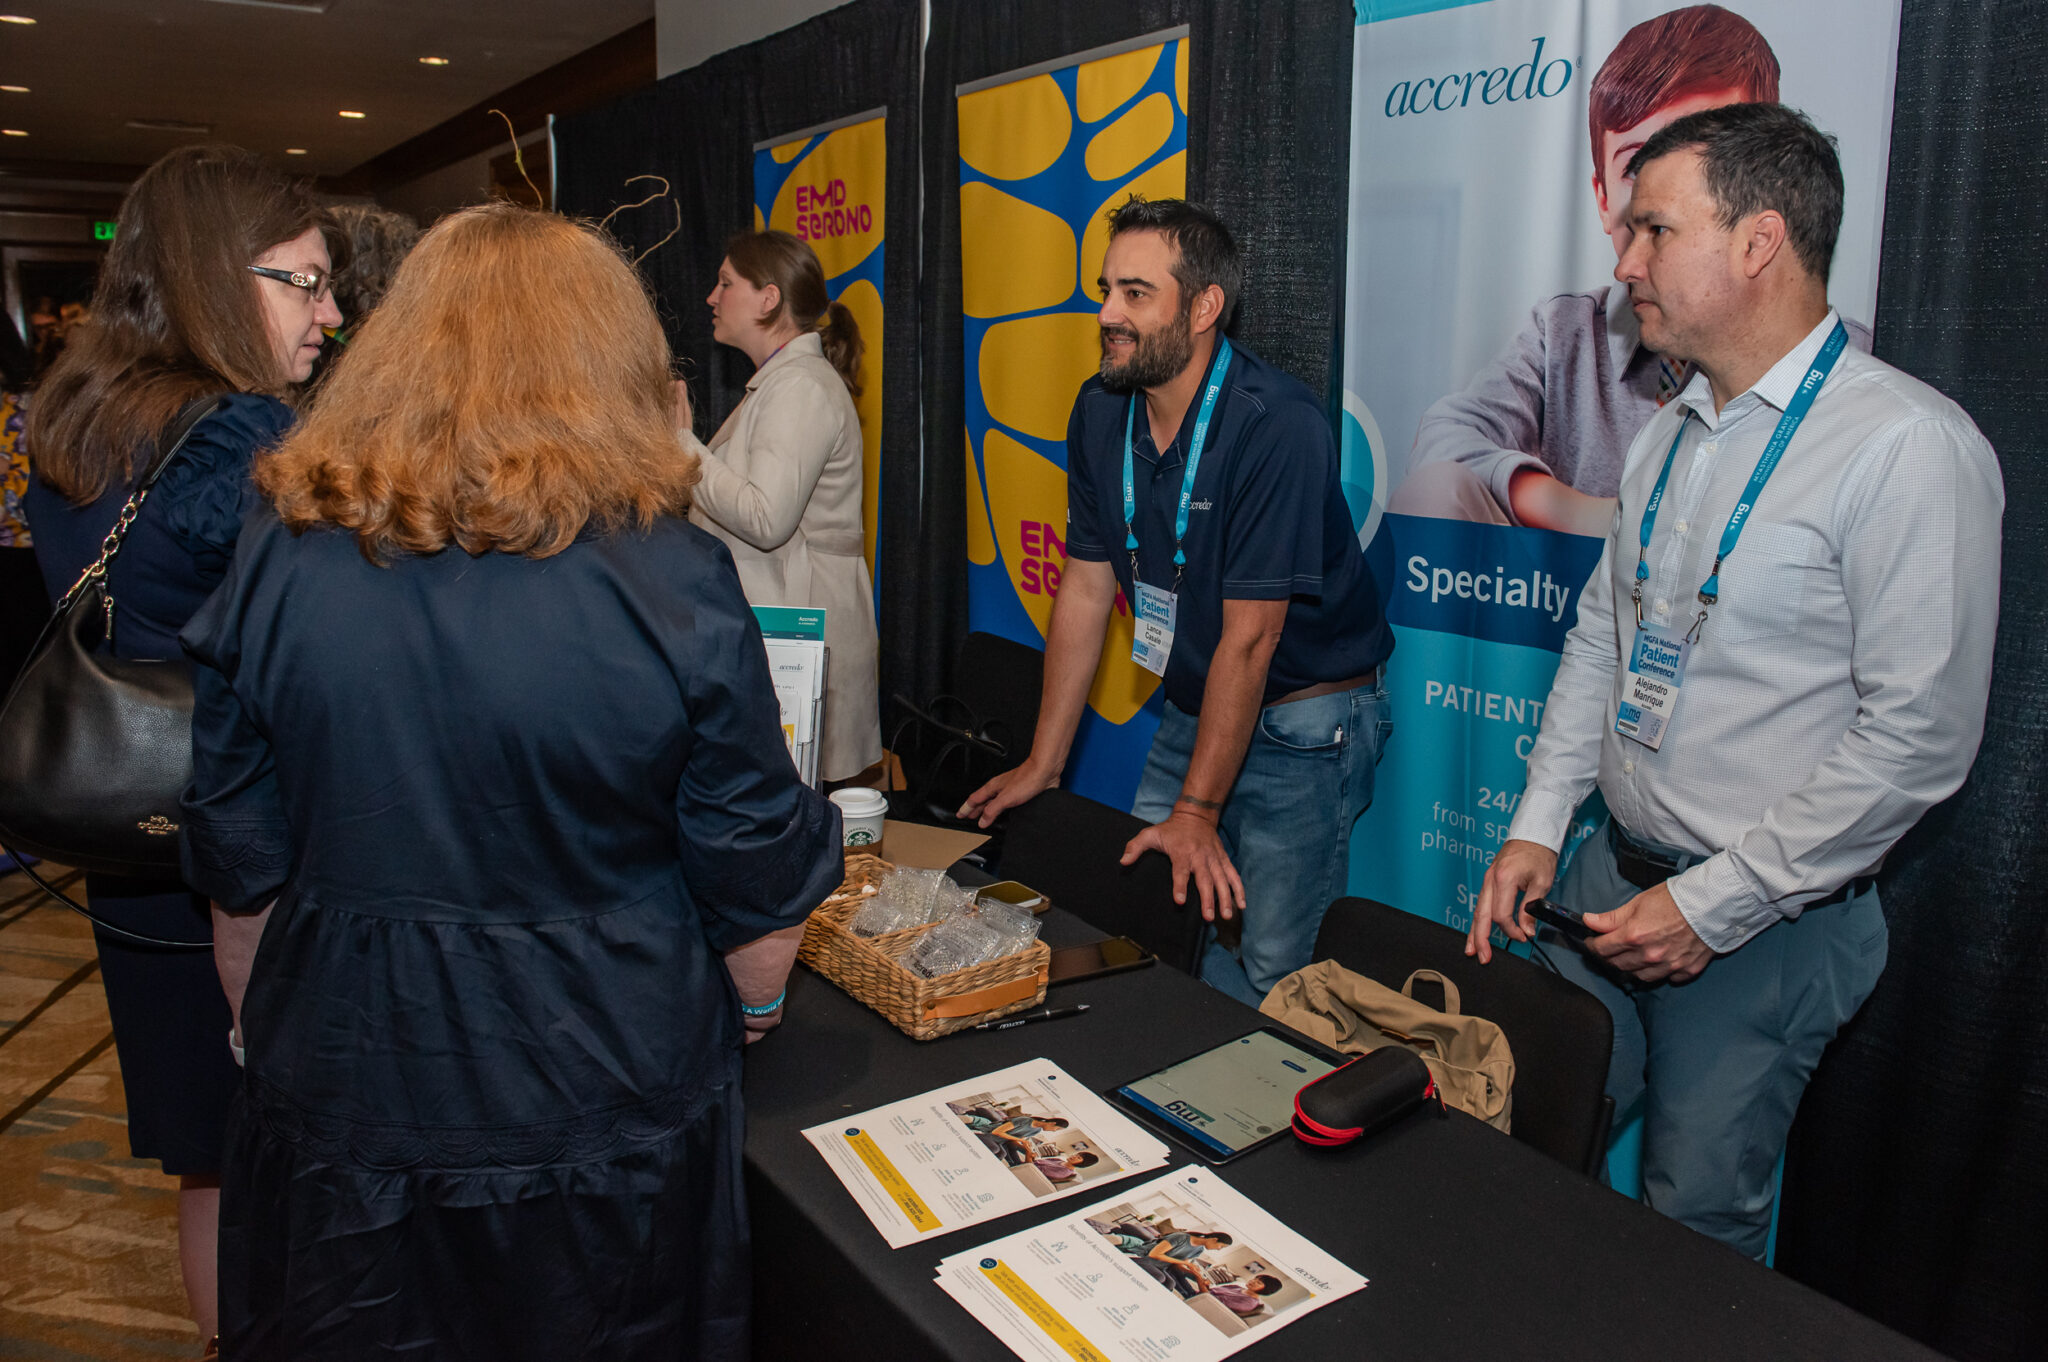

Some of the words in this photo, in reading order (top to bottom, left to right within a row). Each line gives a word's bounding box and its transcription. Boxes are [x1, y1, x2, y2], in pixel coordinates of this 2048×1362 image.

[1384, 36, 1573, 118] accredo
[796, 179, 846, 211] EMD
[1804, 369, 1824, 390] mg
[1732, 503, 1750, 524] mg
[1406, 555, 1570, 622] Specialty
[1141, 598, 1170, 618] Patient
[1141, 609, 1169, 626] Conference
[1146, 623, 1162, 636] Lance
[1641, 643, 1679, 668] Patient
[1660, 638, 1681, 652] National
[1638, 659, 1676, 679] Conference
[1636, 677, 1668, 696] Alejandro
[1633, 689, 1664, 708] Manrique
[1478, 787, 1522, 814] 24/
[1433, 802, 1476, 832] from
[1421, 830, 1496, 866] pharma
[1445, 906, 1469, 931] for
